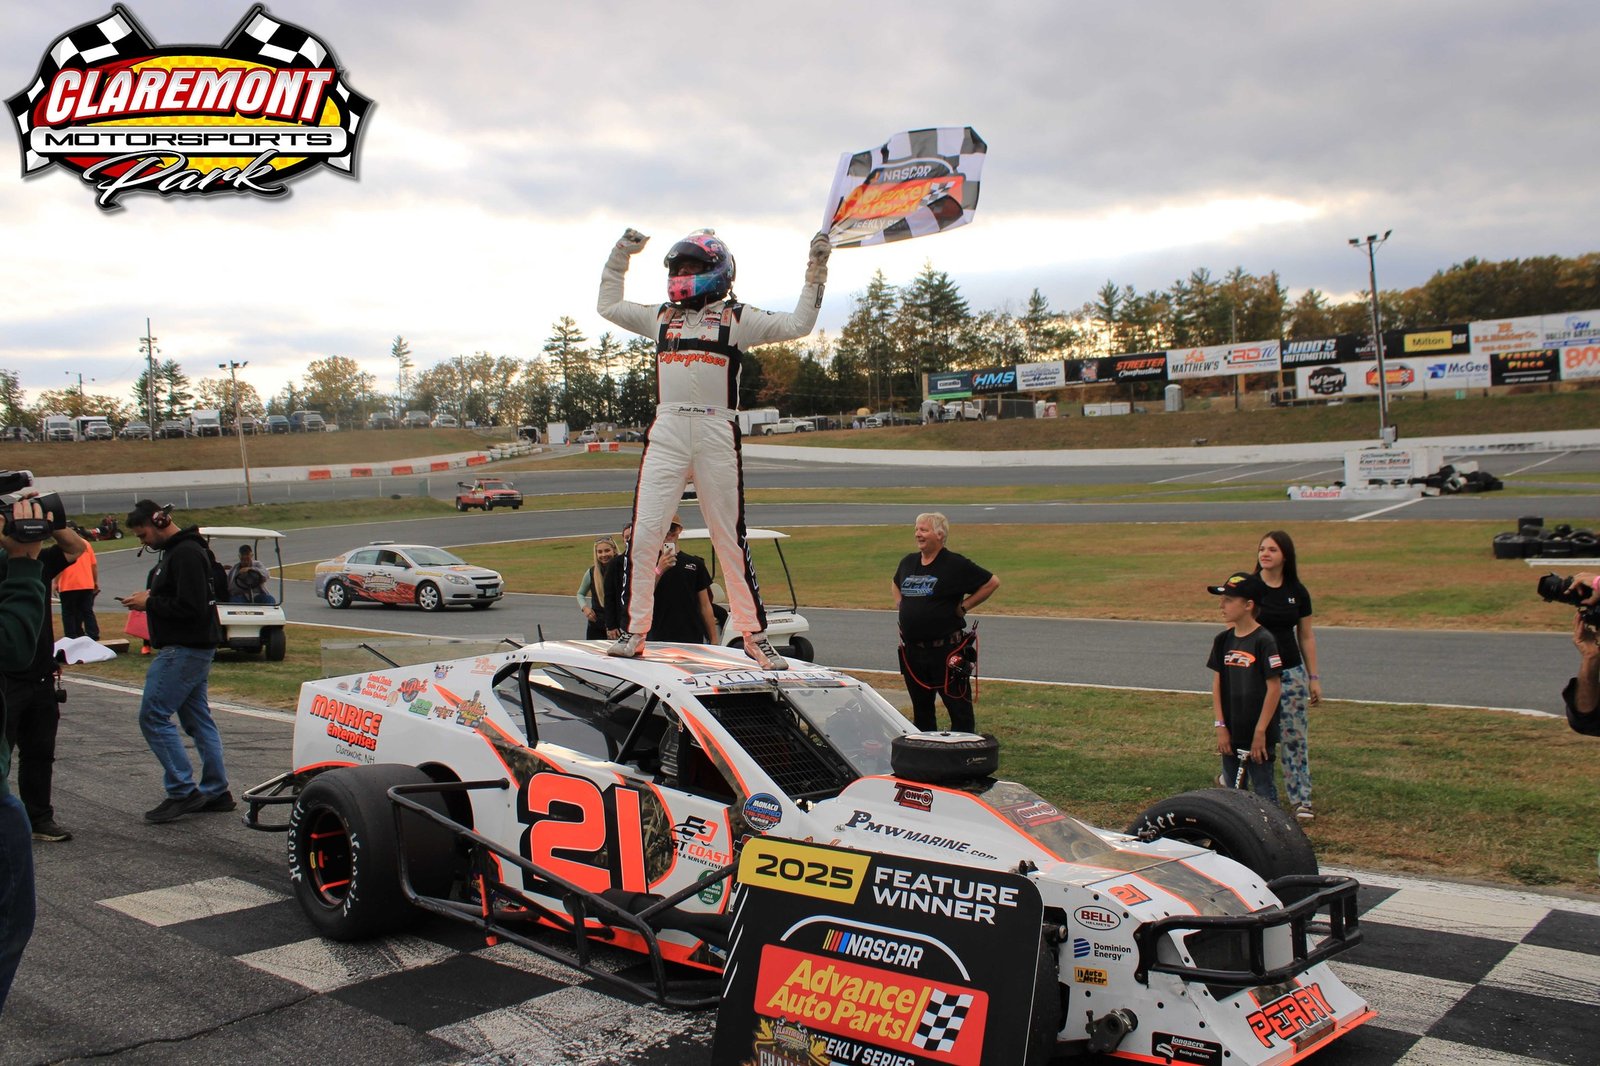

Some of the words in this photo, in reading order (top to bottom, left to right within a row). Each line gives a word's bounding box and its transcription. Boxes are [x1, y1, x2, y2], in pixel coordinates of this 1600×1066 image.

[883, 165, 932, 181] NASCAR
[1282, 339, 1337, 355] JUDD'S
[1412, 336, 1444, 346] Milton
[1282, 350, 1337, 362] AUTOMOTIVE
[1115, 357, 1165, 371] STREETER
[1172, 361, 1219, 373] MATTHEW'S
[1448, 361, 1489, 373] McGee
[1508, 361, 1544, 369] Place
[975, 371, 1016, 385] HMS
[1301, 491, 1341, 499] CLAREMONT
[310, 694, 383, 736] MAURICE
[326, 723, 377, 751] Enterprises
[746, 804, 781, 818] MODIFIED
[752, 799, 779, 811] MONACO
[521, 771, 648, 895] 21
[688, 844, 729, 865] COAST
[755, 853, 853, 890] 2025
[874, 866, 1018, 907] FEATURE
[1108, 884, 1151, 906] 21
[872, 886, 996, 925] WINNER
[1081, 910, 1114, 924] BELL
[1085, 920, 1111, 928] HELMETS
[845, 933, 924, 969] NASCAR
[1094, 942, 1131, 953] Dominion
[1094, 949, 1122, 961] Energy
[1083, 975, 1107, 984] Meter
[1084, 969, 1103, 977] Auto
[785, 959, 915, 1014] Advance
[766, 986, 832, 1020] Auto
[830, 1000, 905, 1041] Parts
[1246, 983, 1337, 1048] PERRY
[1171, 1036, 1205, 1048] Longacre
[1179, 1049, 1192, 1057] Racing
